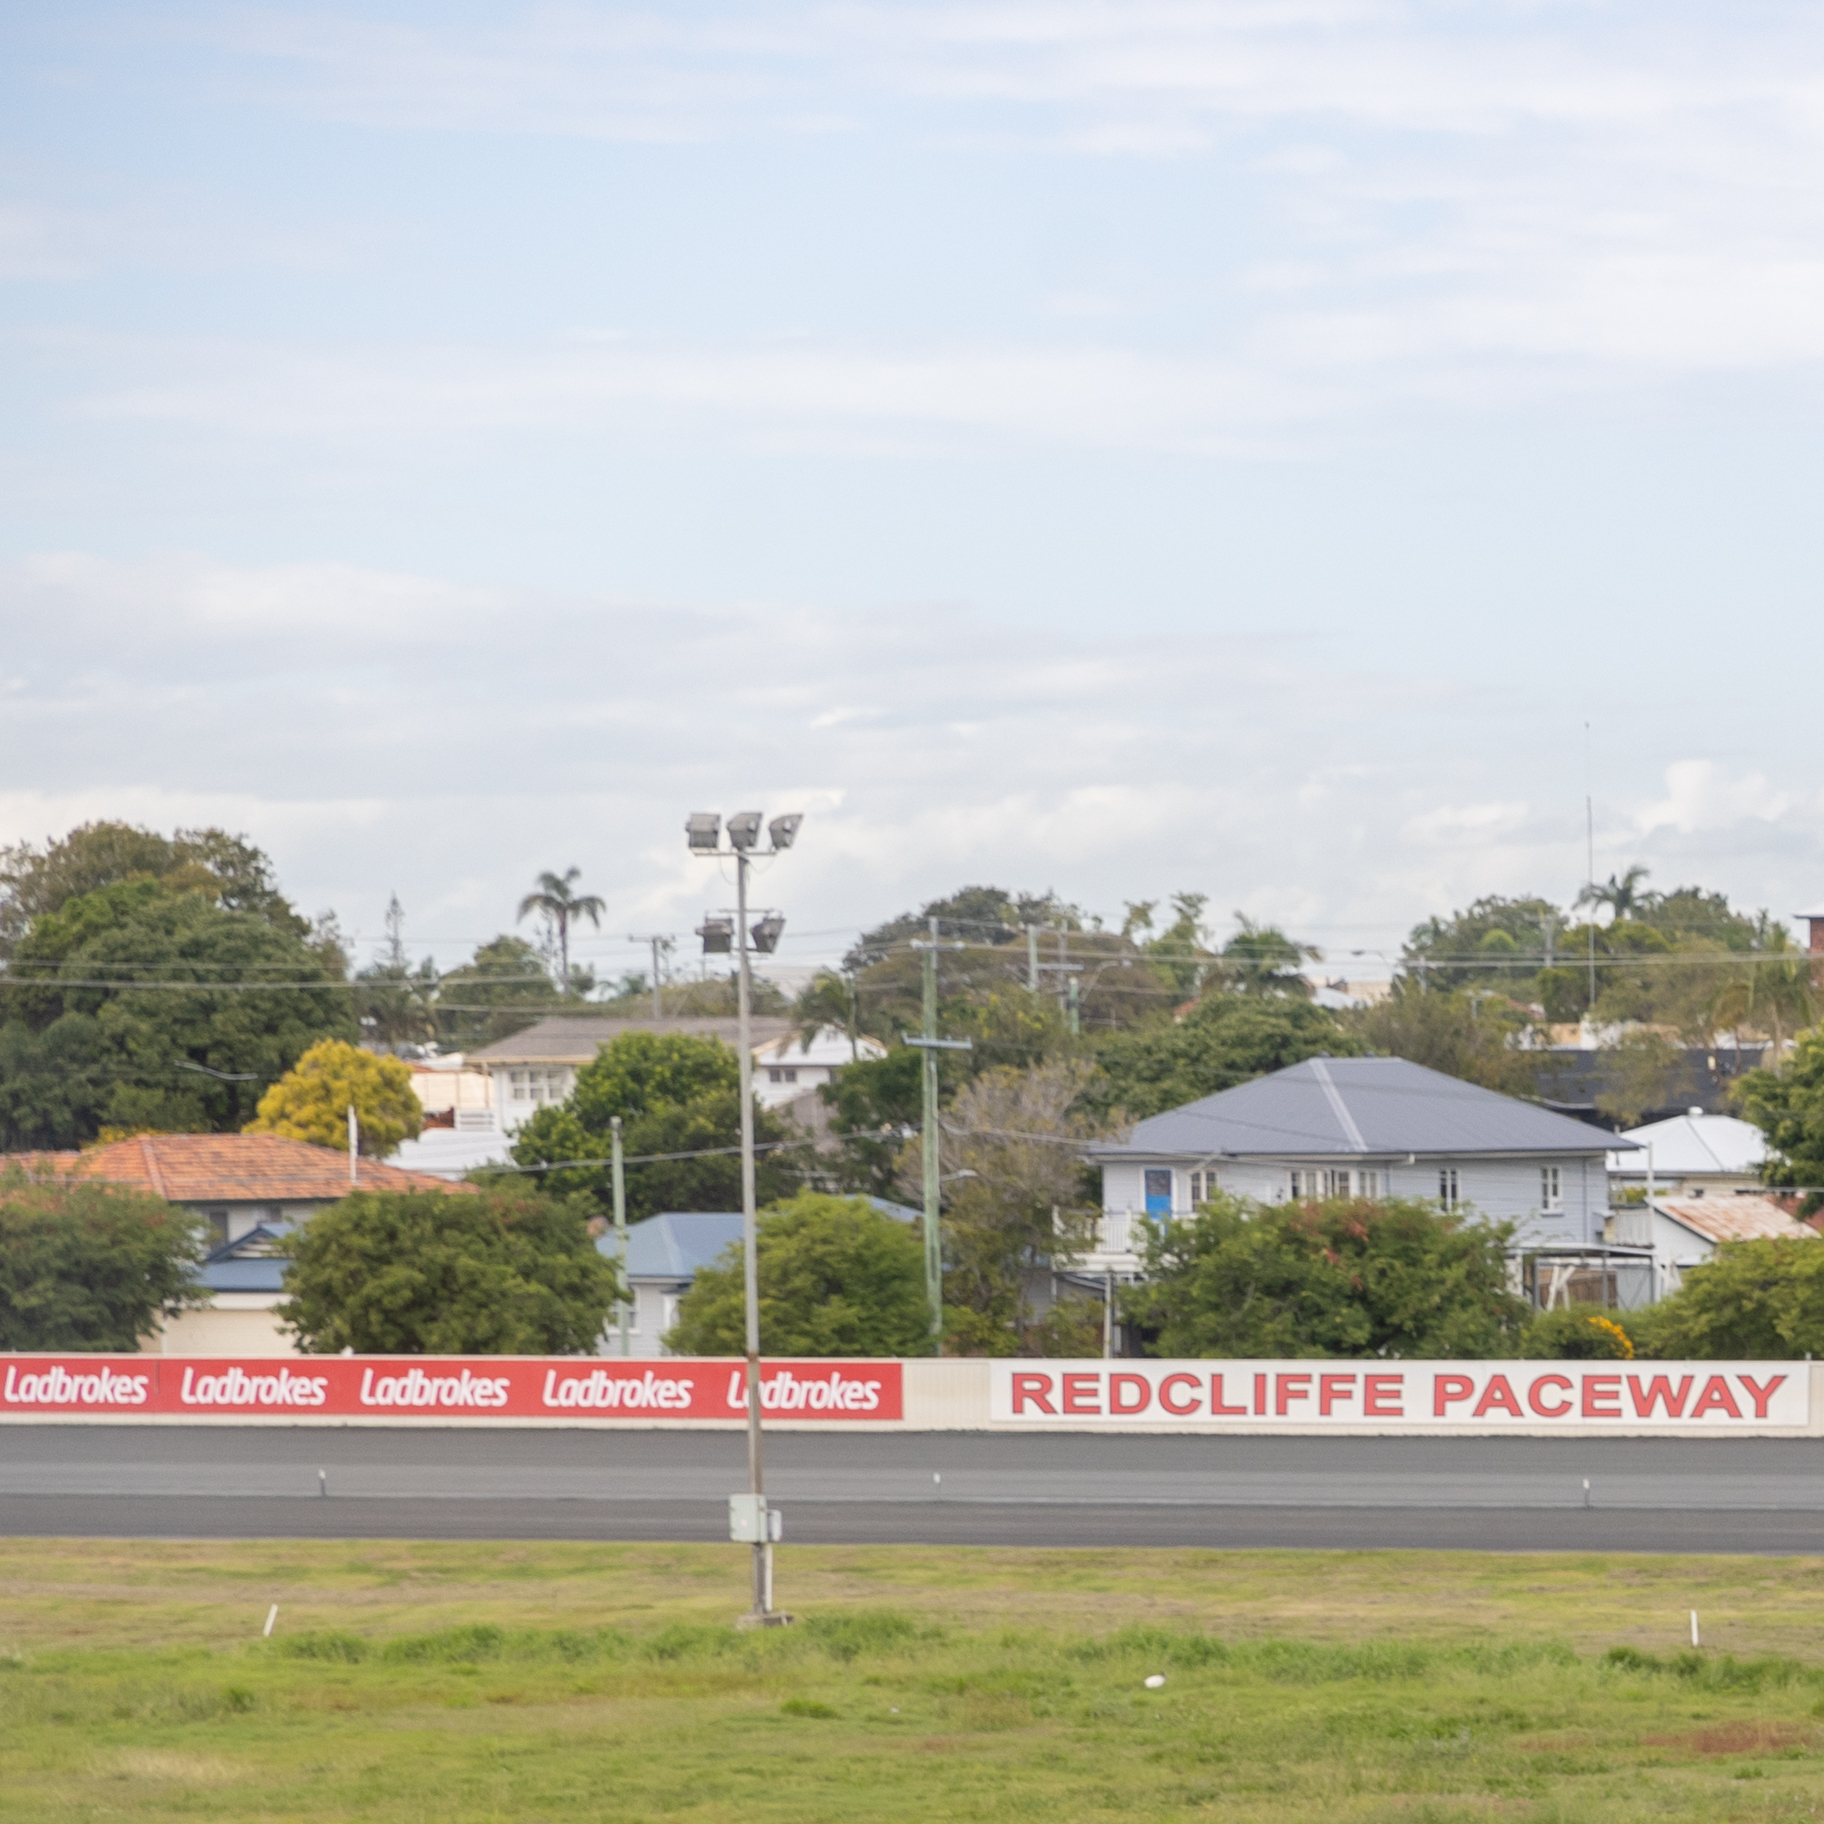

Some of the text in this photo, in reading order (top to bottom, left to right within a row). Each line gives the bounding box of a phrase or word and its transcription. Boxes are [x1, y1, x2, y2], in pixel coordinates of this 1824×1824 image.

[4, 1365, 149, 1405] Ladbrokes
[180, 1366, 328, 1406] Ladbrokes
[360, 1368, 511, 1407] Ladbrokes
[542, 1369, 694, 1409] Ladbrokes
[1011, 1372, 1788, 1419] REDCLIFFE PACEWAY
